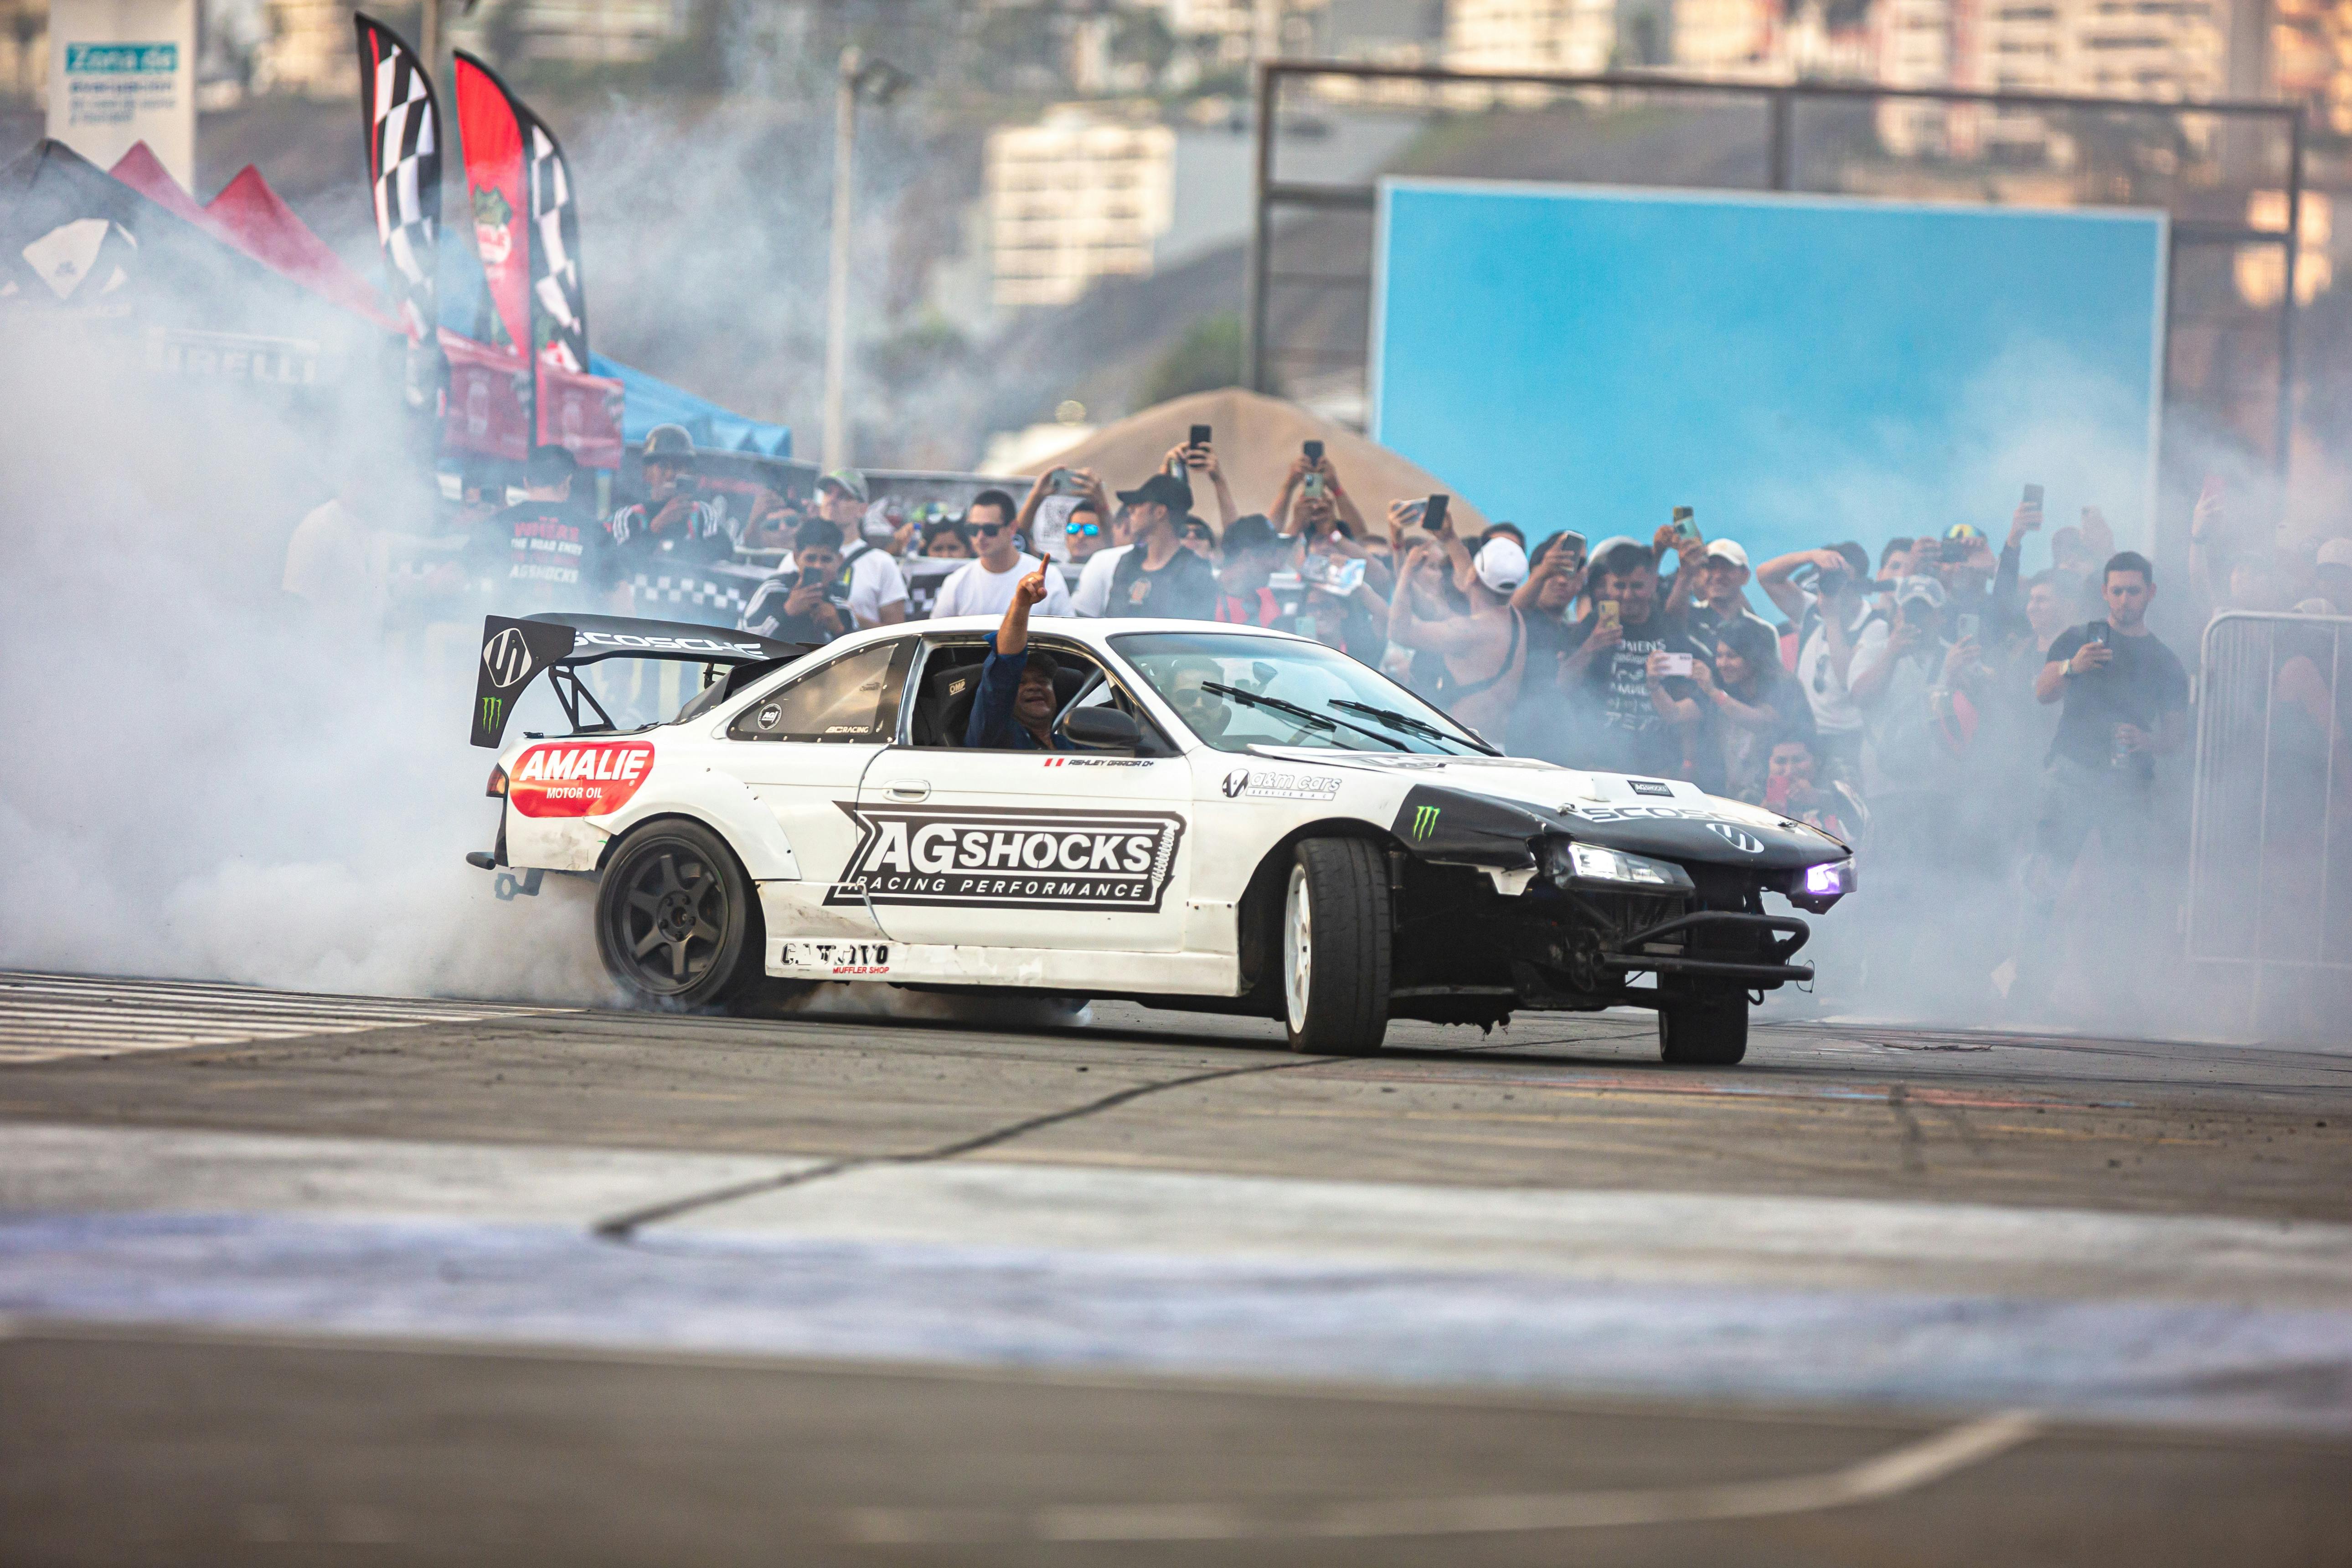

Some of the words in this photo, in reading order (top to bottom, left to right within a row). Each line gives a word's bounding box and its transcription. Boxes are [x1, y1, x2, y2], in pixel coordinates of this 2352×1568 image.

[949, 680, 965, 694] OMP
[519, 749, 650, 781] AMALIE
[547, 787, 583, 799] MOTOR
[586, 787, 603, 799] OIL
[1298, 776, 1342, 792] cars
[862, 821, 1153, 874] AGSHOCKS
[847, 876, 946, 892] RACING
[960, 879, 1145, 897] PERFORMANCE
